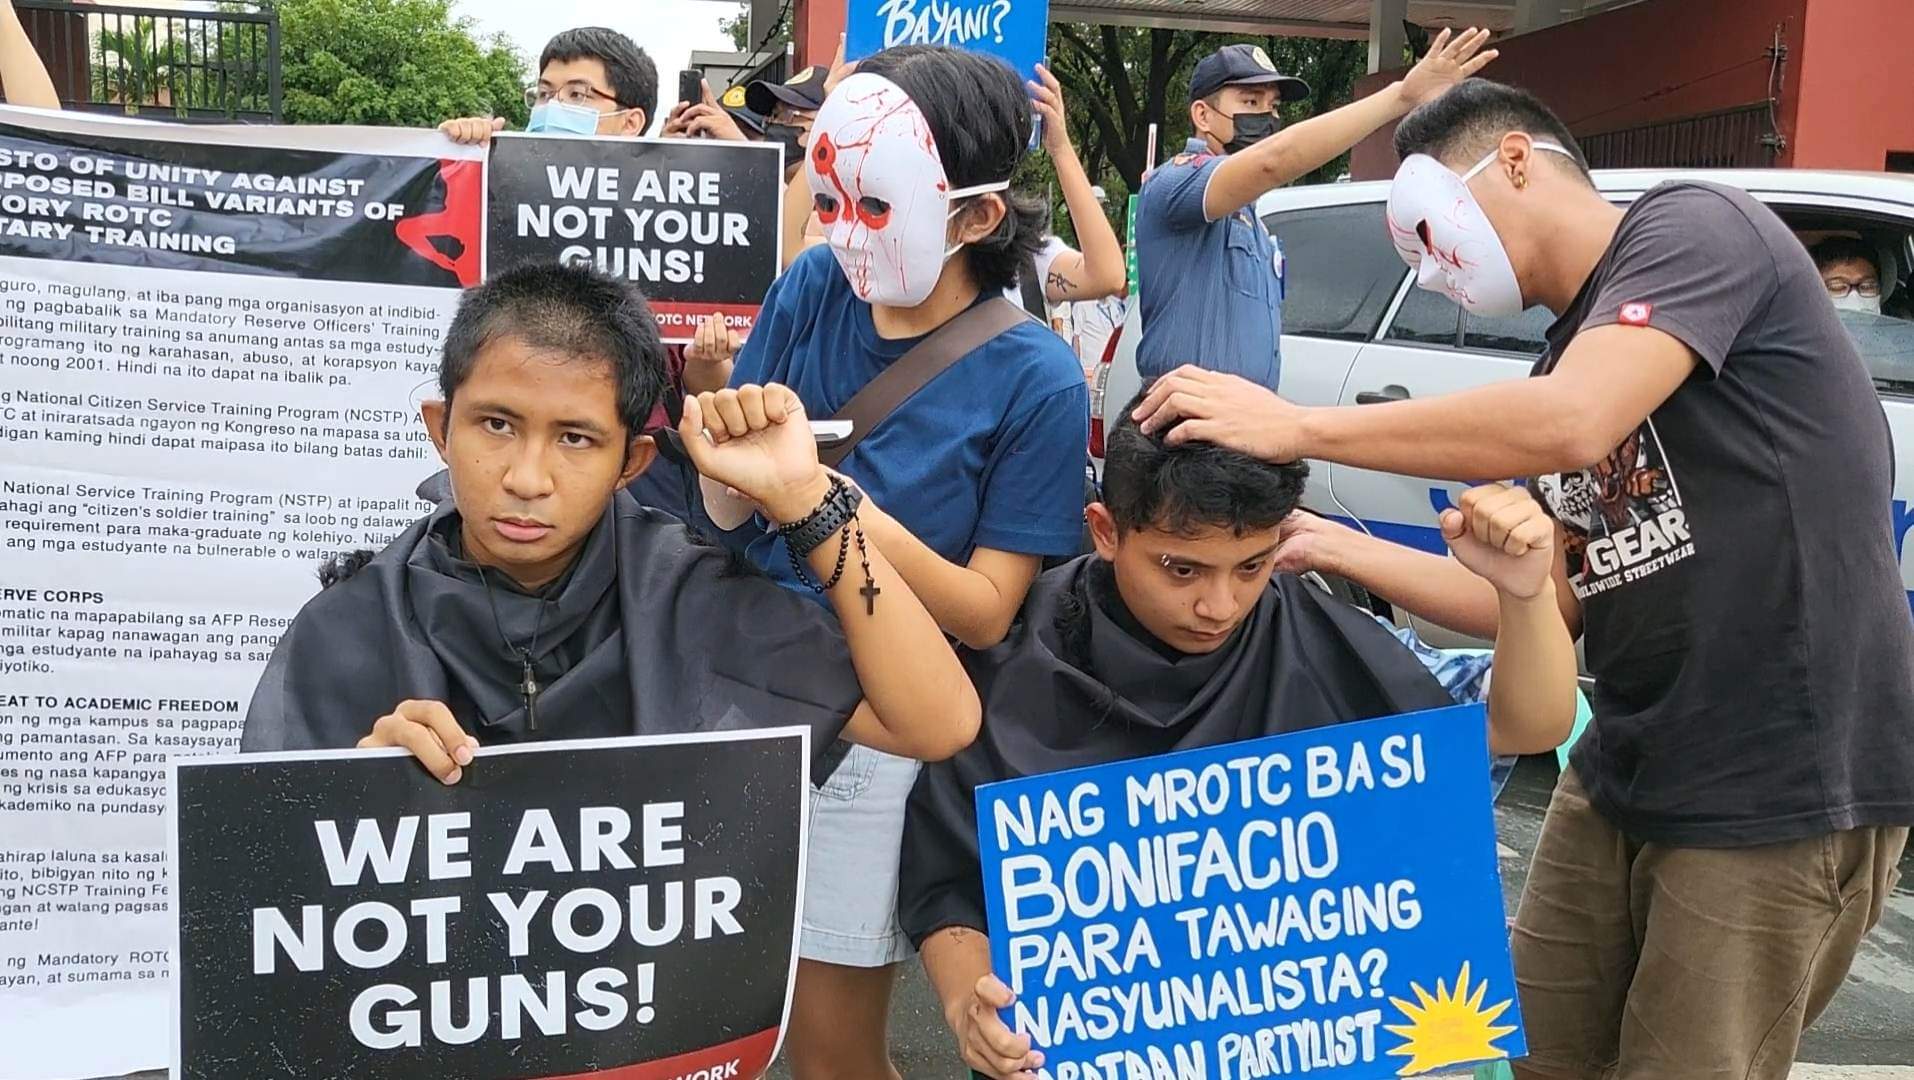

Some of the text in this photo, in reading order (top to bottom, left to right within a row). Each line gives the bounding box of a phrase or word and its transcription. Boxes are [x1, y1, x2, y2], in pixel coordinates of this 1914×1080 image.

[877, 0, 1011, 50] BAYANI?
[69, 156, 115, 176] OF
[125, 162, 222, 186] UNITY
[229, 173, 365, 197] AGAINST
[546, 165, 721, 206] WE ARE
[0, 172, 405, 221] POSED BILL VARIANTS OF
[0, 194, 173, 227] ORY ROTC
[84, 225, 237, 254] TRAINING
[517, 203, 750, 246] NOT YOUR
[0, 280, 440, 320] guro, magulang, iba pang mga organisasyon at indibid-
[33, 300, 439, 340] pagbabalik Mandatory Reserve Officers' Training
[654, 313, 752, 328] OTC NEORK
[59, 320, 440, 358] military training sa anumang antas mga estudy-
[10, 355, 351, 387] noong 2001. Hindi ito dapat ibalik pa.
[94, 339, 113, 353] ito
[148, 343, 234, 363] karahasan,
[242, 351, 293, 367] abuso,
[301, 355, 315, 366] at
[323, 354, 397, 372] korapsyon
[405, 359, 441, 375] kaya
[16, 389, 408, 426] National Citizen Service Training Program (NCSTP)
[21, 409, 400, 441] at iniraratsada ngayon Kongreso mapasa sa
[44, 427, 427, 459] kaming hindi dapat maipasa ito bilang batas dahil:
[3, 480, 409, 513] National Service Training Program (NSTP) ipapalit
[5, 518, 357, 546] requirement para maka-graduate kolehiyo.
[47, 503, 77, 517] ang
[156, 506, 208, 520] soldier
[305, 512, 336, 525] loob
[340, 516, 358, 529] ng
[6, 537, 290, 558] ang mga estudyante bulnerable o
[1586, 508, 1690, 576] GEAR
[1622, 543, 1695, 582] STREETWEAR
[43, 590, 104, 604] CORPS
[1, 624, 234, 646] militar kapag nanawagan ang
[74, 611, 243, 627] mapapabilang AFP
[31, 644, 217, 663] estudyante na ipahayag
[34, 695, 238, 712] TO ACADEMIC FREEDOM
[48, 715, 174, 730] mga kampus sa
[20, 732, 241, 748] pamantasan. Sa kasaysayan
[49, 768, 87, 778] nasa
[59, 749, 166, 765] ang AFP para
[27, 782, 90, 795] krisis sa
[995, 783, 1104, 852] NAG
[1126, 753, 1292, 828] MROTC
[51, 849, 96, 863] laluna
[314, 801, 685, 886] WE ARE
[31, 866, 155, 882] bibigyan nito ng
[1000, 810, 1340, 934] BONIFACIO
[22, 884, 146, 898] NCSTP Training
[55, 901, 110, 915] walang
[253, 876, 745, 975] NOT YOUR
[1008, 879, 1422, 996] PARA TAWAGING
[37, 952, 119, 966] Mandatory
[47, 971, 132, 984] at sumama
[348, 962, 656, 1050] GUNS!
[1014, 948, 1389, 1048] NASYUNALISTA?
[1218, 1009, 1382, 1080] PARTYLIST
